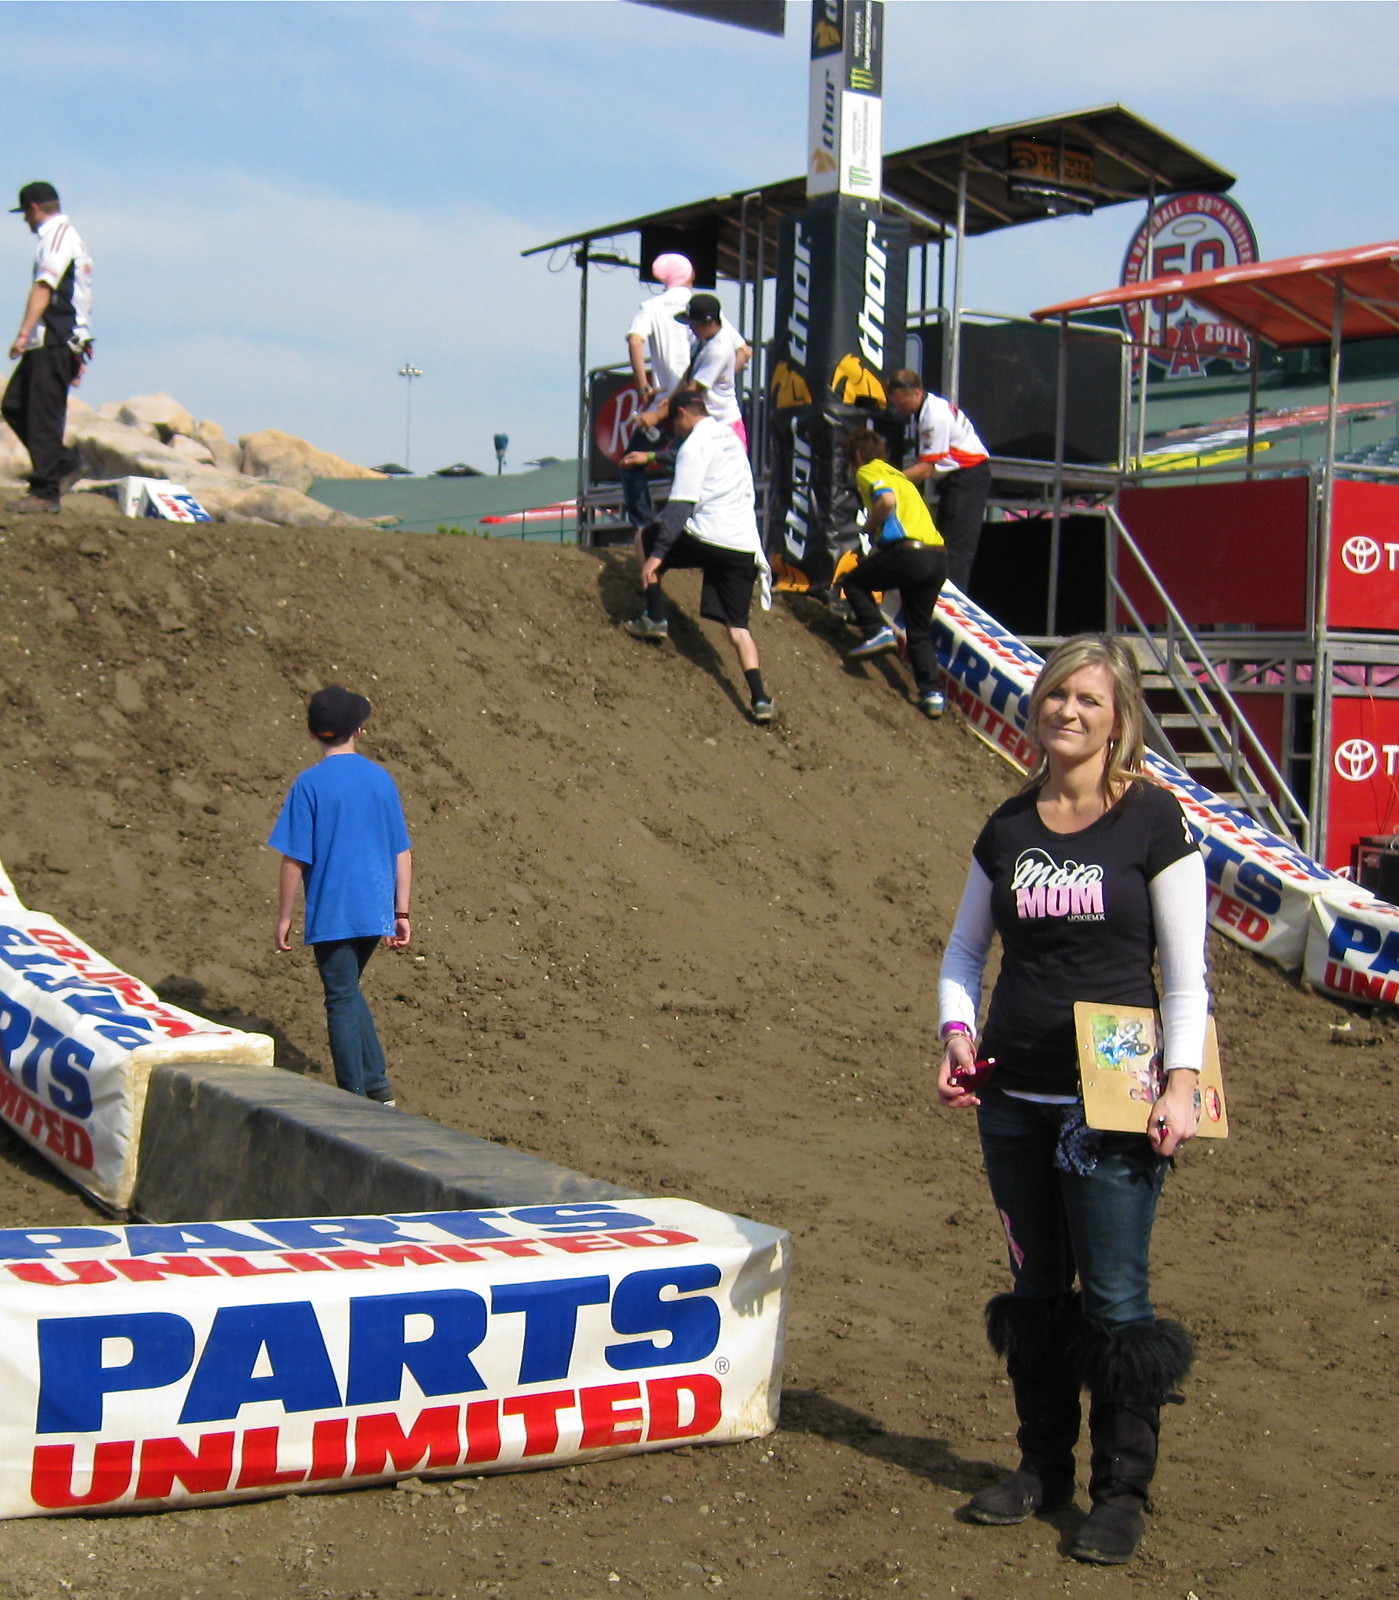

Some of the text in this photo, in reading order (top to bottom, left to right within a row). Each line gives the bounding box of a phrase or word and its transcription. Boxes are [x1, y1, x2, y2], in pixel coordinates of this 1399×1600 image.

[788, 221, 811, 367] thor
[858, 219, 887, 371] thor
[1204, 324, 1240, 346] 2011
[1010, 847, 1104, 890] Moto
[1016, 880, 1105, 919] MOM
[0, 1203, 656, 1260] PARTS
[4, 1229, 699, 1287] UNLIMITED
[36, 1263, 722, 1435] PARTS
[30, 1373, 723, 1509] UNLIMITED
